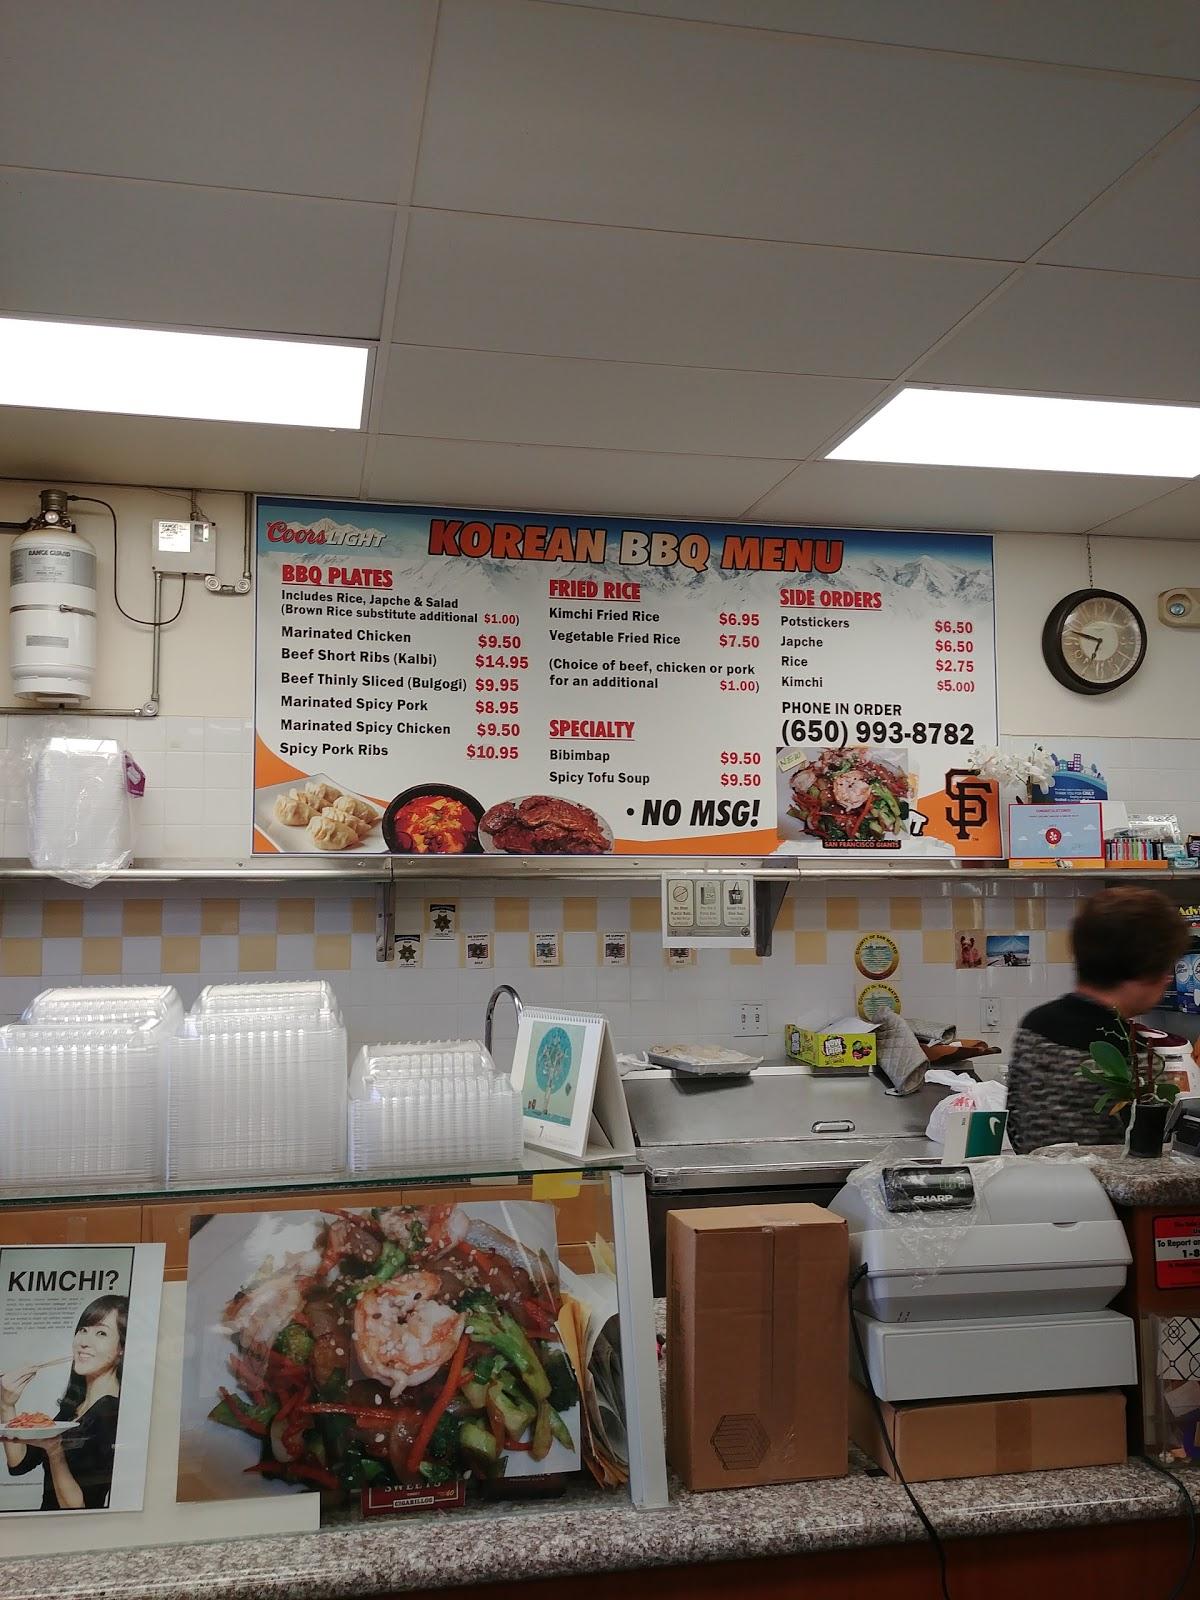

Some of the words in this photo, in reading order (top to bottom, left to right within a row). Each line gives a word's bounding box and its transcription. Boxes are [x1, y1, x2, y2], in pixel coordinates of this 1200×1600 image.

[267, 521, 327, 545] Coors
[326, 532, 387, 548] LIGHT
[428, 519, 607, 564] KOREAN
[619, 531, 710, 572] BBQ
[720, 535, 845, 574] MENU
[282, 564, 322, 585] BBQ
[328, 567, 393, 588] PLATES
[549, 579, 598, 598] FRIED
[603, 582, 641, 600] RICE
[780, 588, 815, 607] SIDE
[820, 590, 882, 608] ORDERS
[281, 590, 333, 602] Includes
[337, 593, 366, 605] Rice,
[369, 595, 411, 607] Japche
[414, 597, 423, 607] &
[426, 597, 459, 609] Salad
[281, 604, 323, 616] (Brown
[326, 606, 353, 617] Rice
[356, 608, 416, 620] substitute
[419, 611, 478, 623] additional
[484, 614, 520, 626] $1.00)
[549, 608, 593, 620] Kimchi
[596, 609, 628, 621] Fried
[632, 610, 660, 622] Rice
[719, 613, 760, 626] $6.95
[780, 616, 850, 629] Potstickers
[934, 621, 973, 635] $6.50
[281, 626, 352, 640] Marinated
[357, 628, 412, 643] Chicken
[478, 634, 522, 650] $9.50
[549, 630, 614, 644] Vegetable
[617, 632, 649, 644] Fried
[653, 633, 681, 645] Rice
[719, 635, 760, 648] $7.50
[780, 636, 823, 649] Japche
[935, 639, 973, 653] $6.50
[281, 648, 314, 661] Beef
[317, 649, 357, 662] Short
[360, 650, 390, 664] Ribs
[393, 652, 438, 667] (Kalbi)
[475, 655, 529, 670] $14.95
[549, 658, 598, 671] (Choice
[602, 660, 616, 671] of
[619, 661, 652, 674] beef,
[656, 662, 706, 674] chicken
[710, 665, 723, 674] or
[726, 664, 755, 676] pork
[781, 656, 808, 668] Rice
[935, 659, 974, 673] $2.75
[281, 672, 314, 685] Beef
[317, 673, 358, 688] Thinly
[362, 675, 404, 688] Sliced
[407, 677, 467, 692] (Bulgogi)
[475, 678, 519, 693] $9.95
[549, 675, 569, 686] for
[572, 677, 589, 687] an
[592, 676, 658, 689] additional
[720, 680, 760, 693] $1.00)
[781, 676, 823, 688] Kimchi
[937, 679, 975, 693] $5.00)
[281, 695, 352, 709] Marinated
[355, 697, 394, 713] Spicy
[397, 698, 429, 712] Pork
[475, 700, 519, 715] $8.95
[781, 702, 831, 715] PHONE
[835, 703, 849, 715] IN
[854, 703, 902, 716] ORDER
[280, 719, 352, 732] Marinated
[356, 720, 394, 736] Spicy
[397, 720, 451, 735] Chicken
[477, 722, 521, 737] $9.50
[549, 720, 635, 739] SPECIALTY
[781, 719, 848, 746] (650)
[856, 721, 974, 745] 993-8782
[280, 742, 319, 758] Spicy
[322, 743, 355, 756] Pork
[358, 743, 389, 756] Ribs
[466, 744, 519, 760] $10.95
[550, 749, 610, 763] Bibimbap
[720, 752, 761, 765] $9.50
[549, 772, 584, 784] Spicy
[588, 772, 614, 783] Tofu
[618, 773, 650, 785] Soup
[720, 773, 761, 787] $9.50
[641, 800, 682, 826] NO
[690, 799, 760, 827] MSG!
[913, 1194, 953, 1203] SHARP
[1157, 1240, 1165, 1248] To
[1168, 1239, 1191, 1249] Report
[7, 1269, 119, 1292] KIMCHI?
